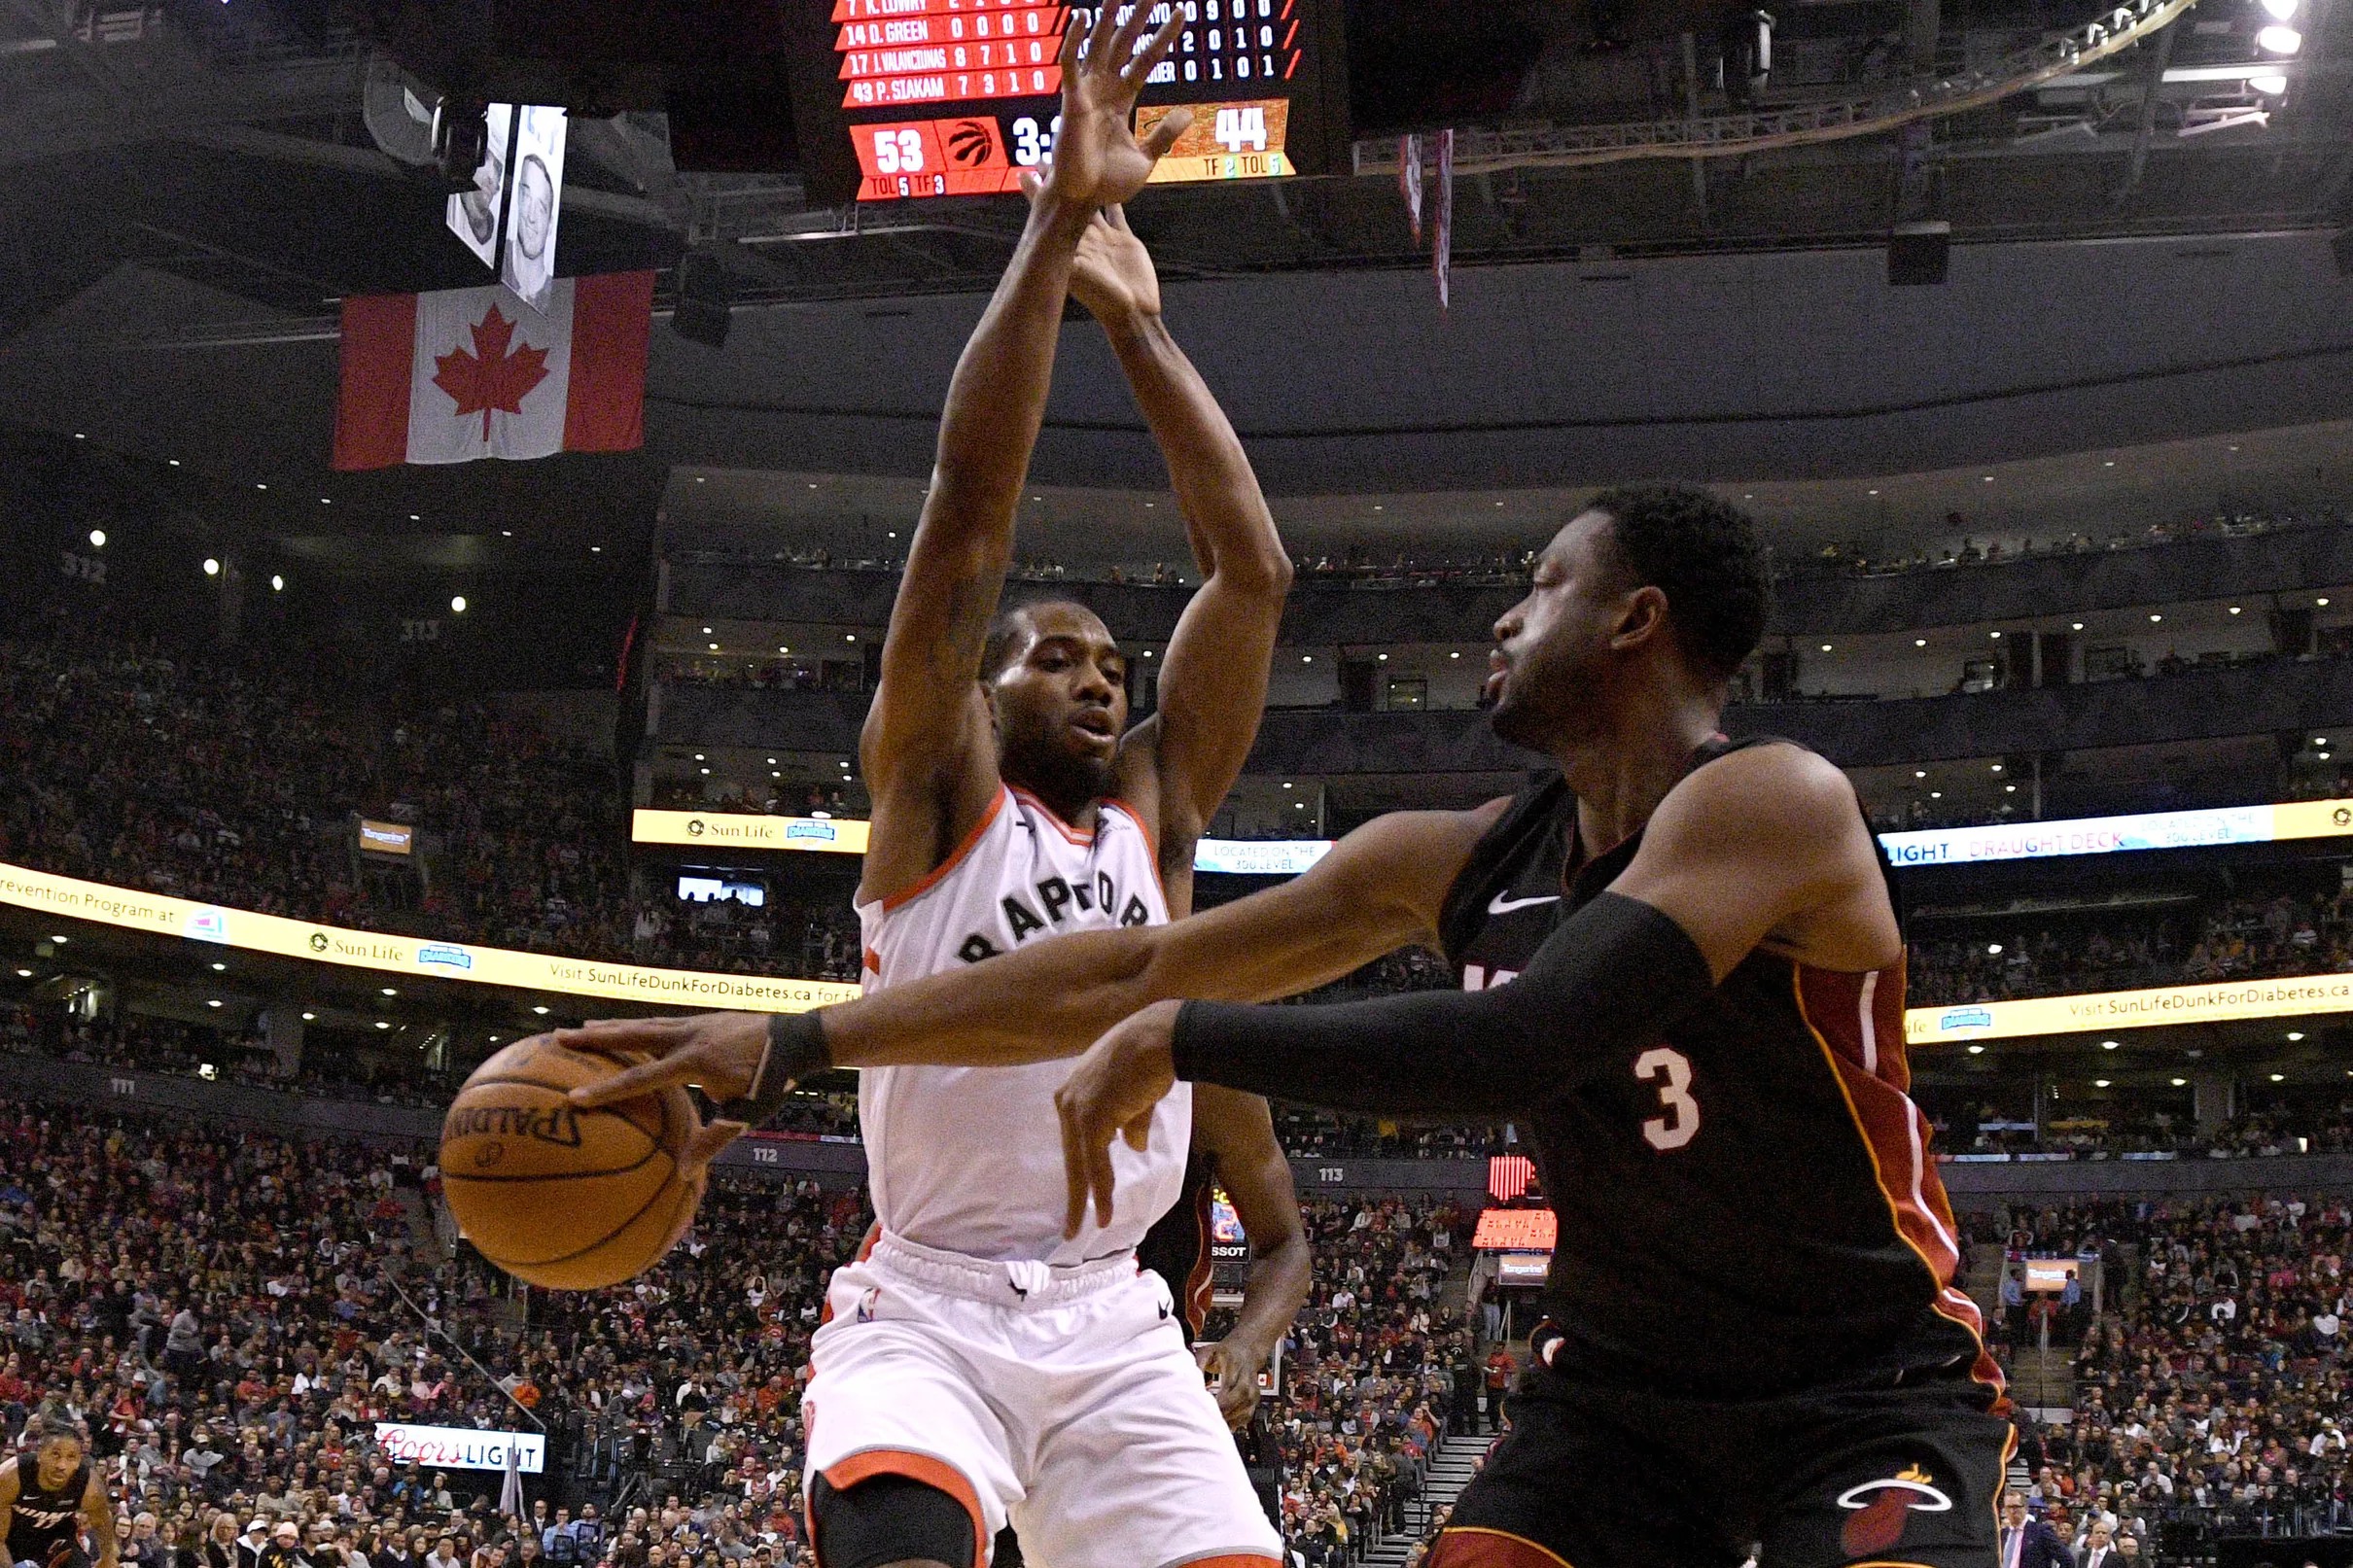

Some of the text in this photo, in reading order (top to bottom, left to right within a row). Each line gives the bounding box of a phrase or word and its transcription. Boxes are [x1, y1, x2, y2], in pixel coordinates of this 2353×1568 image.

[1207, 0, 1218, 20] 9
[1233, 0, 1246, 19] 0
[846, 25, 866, 46] 14
[885, 19, 929, 43] GREEN
[951, 17, 964, 38] 0
[976, 16, 989, 36] 0
[1001, 14, 1014, 34] 0
[1027, 12, 1039, 33] 0
[1182, 31, 1195, 52] 2
[1209, 29, 1221, 50] 0
[1236, 27, 1247, 49] 1
[1260, 25, 1273, 47] 0
[849, 53, 868, 75] 17
[881, 48, 947, 73] VALANCIUNAS
[954, 47, 966, 67] 8
[980, 45, 991, 65] 7
[1005, 43, 1016, 64] 1
[1030, 42, 1041, 62] 0
[1184, 59, 1197, 81] 0
[1212, 58, 1223, 80] 1
[1237, 56, 1249, 78] 0
[1263, 54, 1274, 76] 1
[853, 70, 1044, 103] 43 P. SIAKAM 7 3 1 0
[1215, 107, 1268, 153] 44
[873, 128, 925, 173] 53
[1204, 158, 1219, 176] TF
[1241, 156, 1266, 174] TOL
[871, 174, 945, 196] TOL 5 TF 3
[711, 822, 740, 837] Sun
[745, 823, 774, 840] Life
[1970, 835, 2063, 857] DRAUGHT
[2070, 831, 2126, 851] DECK
[1214, 846, 1269, 856] LOCATED
[85, 892, 154, 919] Program
[158, 910, 175, 923] at
[334, 939, 368, 957] Sun
[372, 944, 404, 961] Life
[549, 962, 582, 981] Visit
[587, 969, 812, 1001] SunLifeDunkForDiabetes.ca
[818, 987, 840, 1003] for
[2069, 985, 2350, 1016] Visit SunLifeDunkForDiabetes.ca
[110, 1077, 135, 1096] 111
[1634, 1047, 1701, 1151] 3
[753, 1147, 778, 1163] 112
[1318, 1167, 1344, 1182] 113
[379, 1428, 537, 1468] Coors LIGHT
